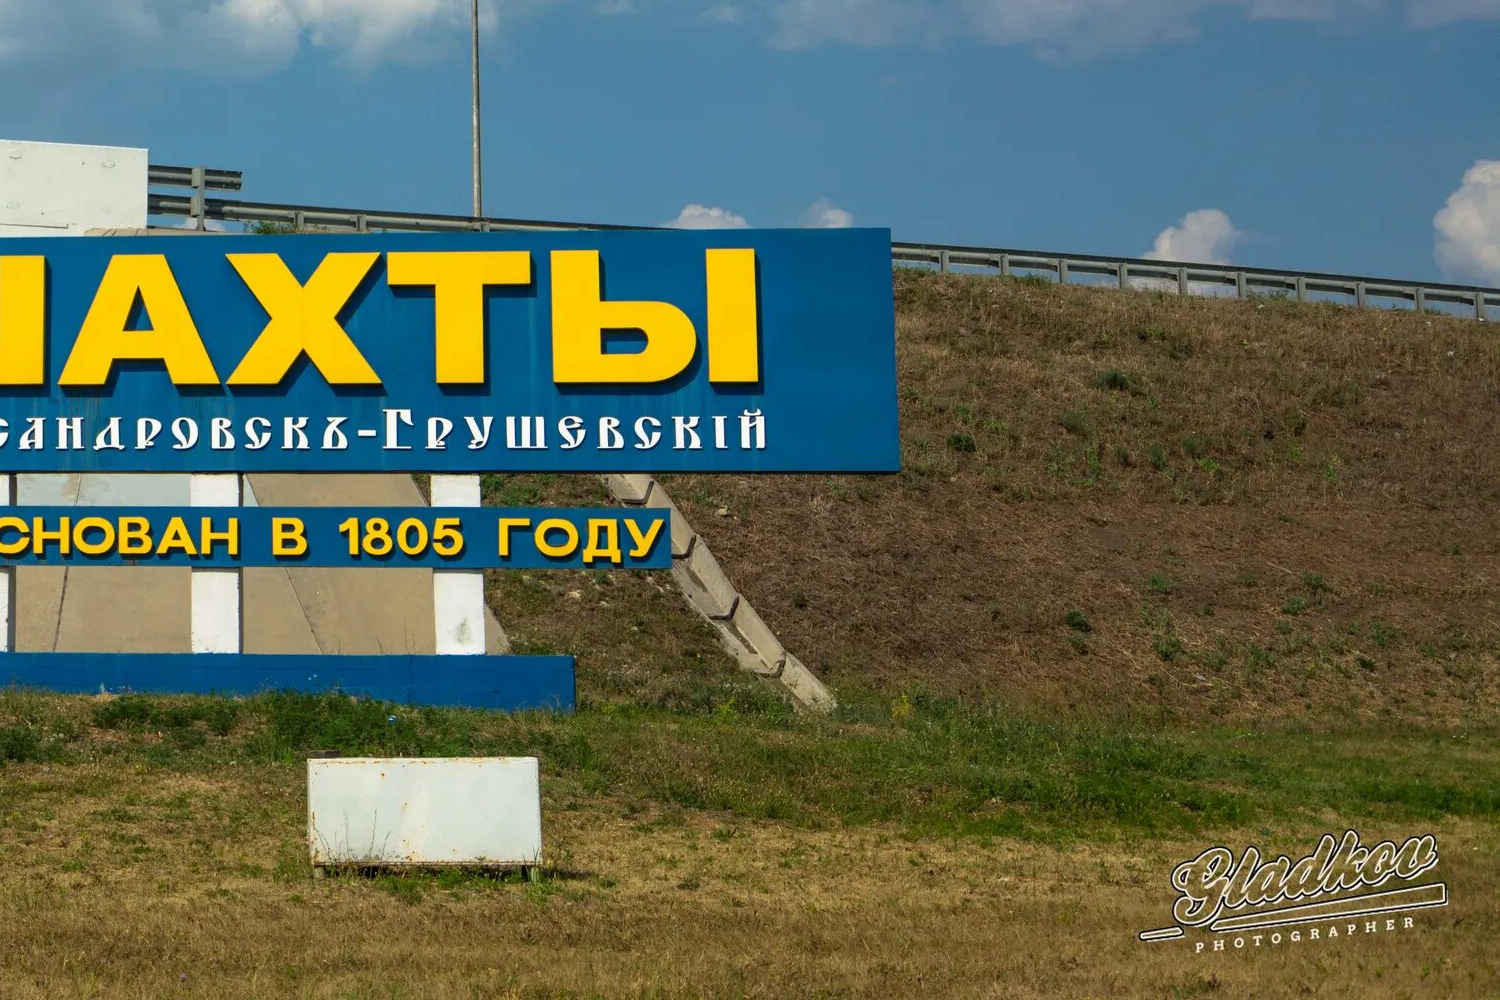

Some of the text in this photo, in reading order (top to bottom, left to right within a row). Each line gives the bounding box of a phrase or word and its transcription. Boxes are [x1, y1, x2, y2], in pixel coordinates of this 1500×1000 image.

[272, 517, 308, 556] В
[338, 517, 465, 557] 1805
[498, 518, 665, 564] ГОДУ
